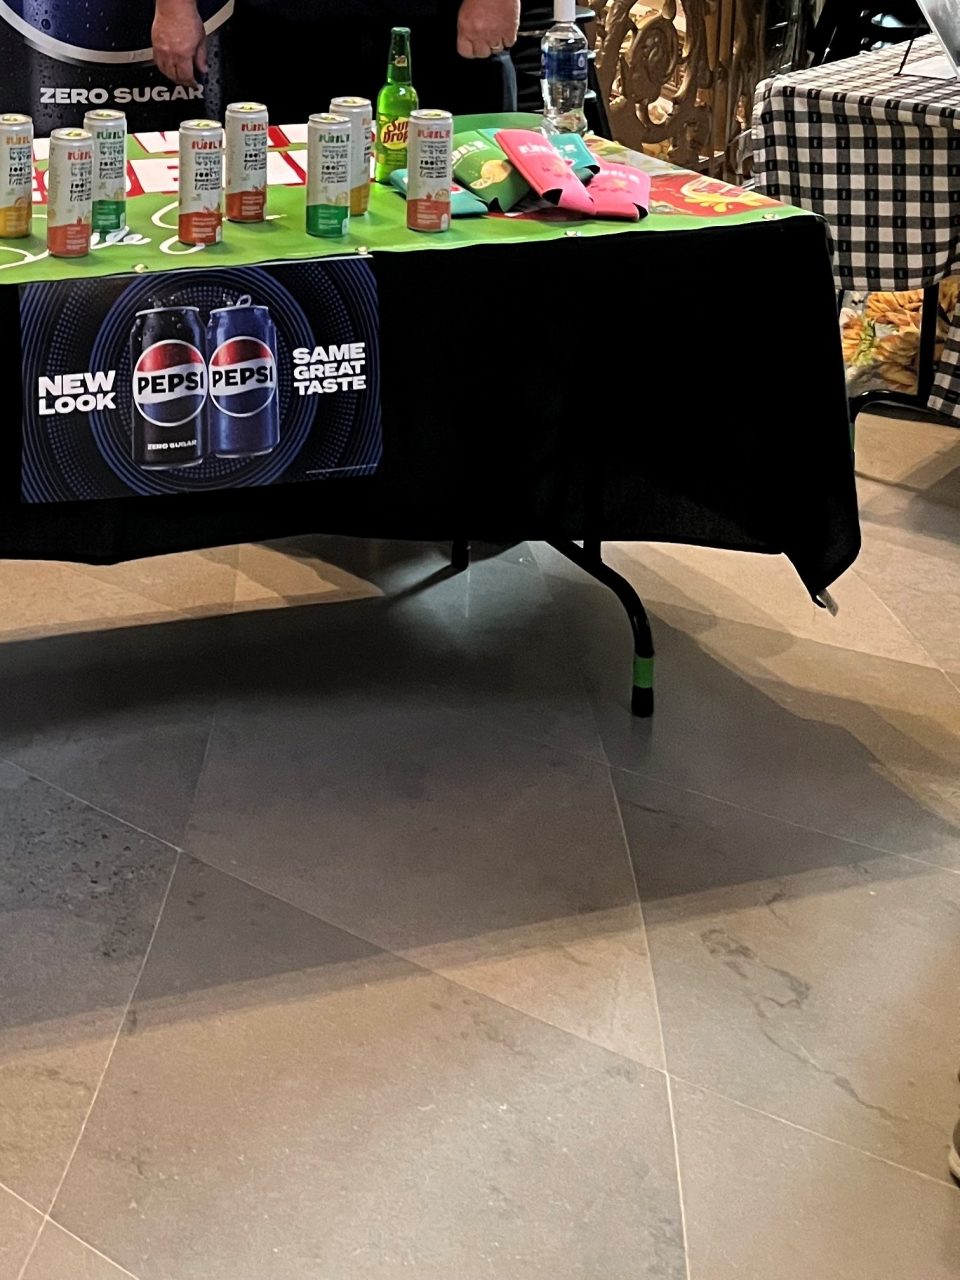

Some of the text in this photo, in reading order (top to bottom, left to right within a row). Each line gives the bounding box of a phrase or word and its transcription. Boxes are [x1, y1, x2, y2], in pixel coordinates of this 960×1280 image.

[40, 83, 204, 104] ZERO SUGAR
[293, 342, 366, 364] SAME
[212, 366, 273, 387] PEPSI
[294, 360, 366, 380] GREAT
[38, 370, 116, 397] NEW
[138, 371, 204, 395] PEPSI
[294, 376, 367, 395] TASTE
[38, 392, 117, 415] LOOK
[169, 440, 197, 448] SUGAR
